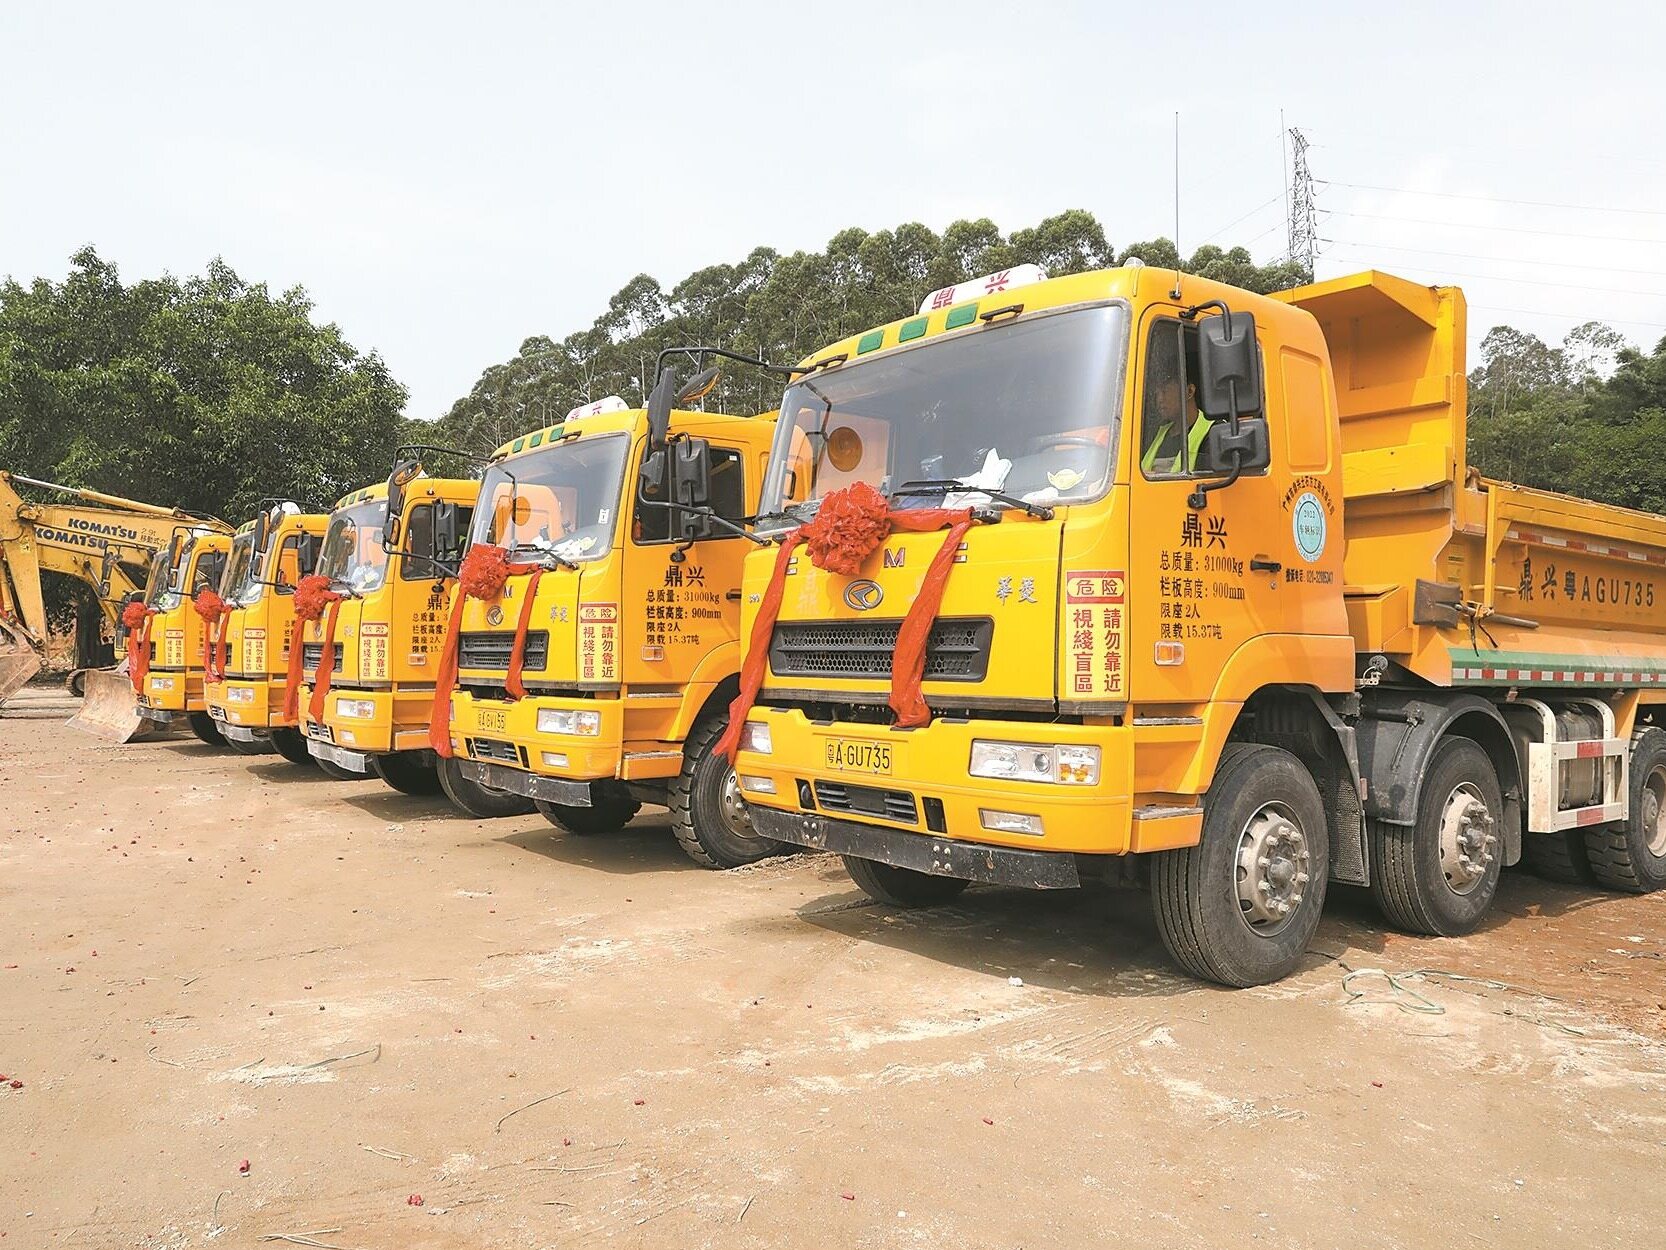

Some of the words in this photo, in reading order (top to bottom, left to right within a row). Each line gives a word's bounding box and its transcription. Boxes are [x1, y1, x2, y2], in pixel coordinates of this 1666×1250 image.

[68, 518, 137, 540] KOMATSU
[1181, 512, 1228, 549] 鼎兴
[664, 565, 705, 587] 鼎兴
[1076, 579, 1119, 596] 危险
[1103, 607, 1122, 693] 請勿靠近
